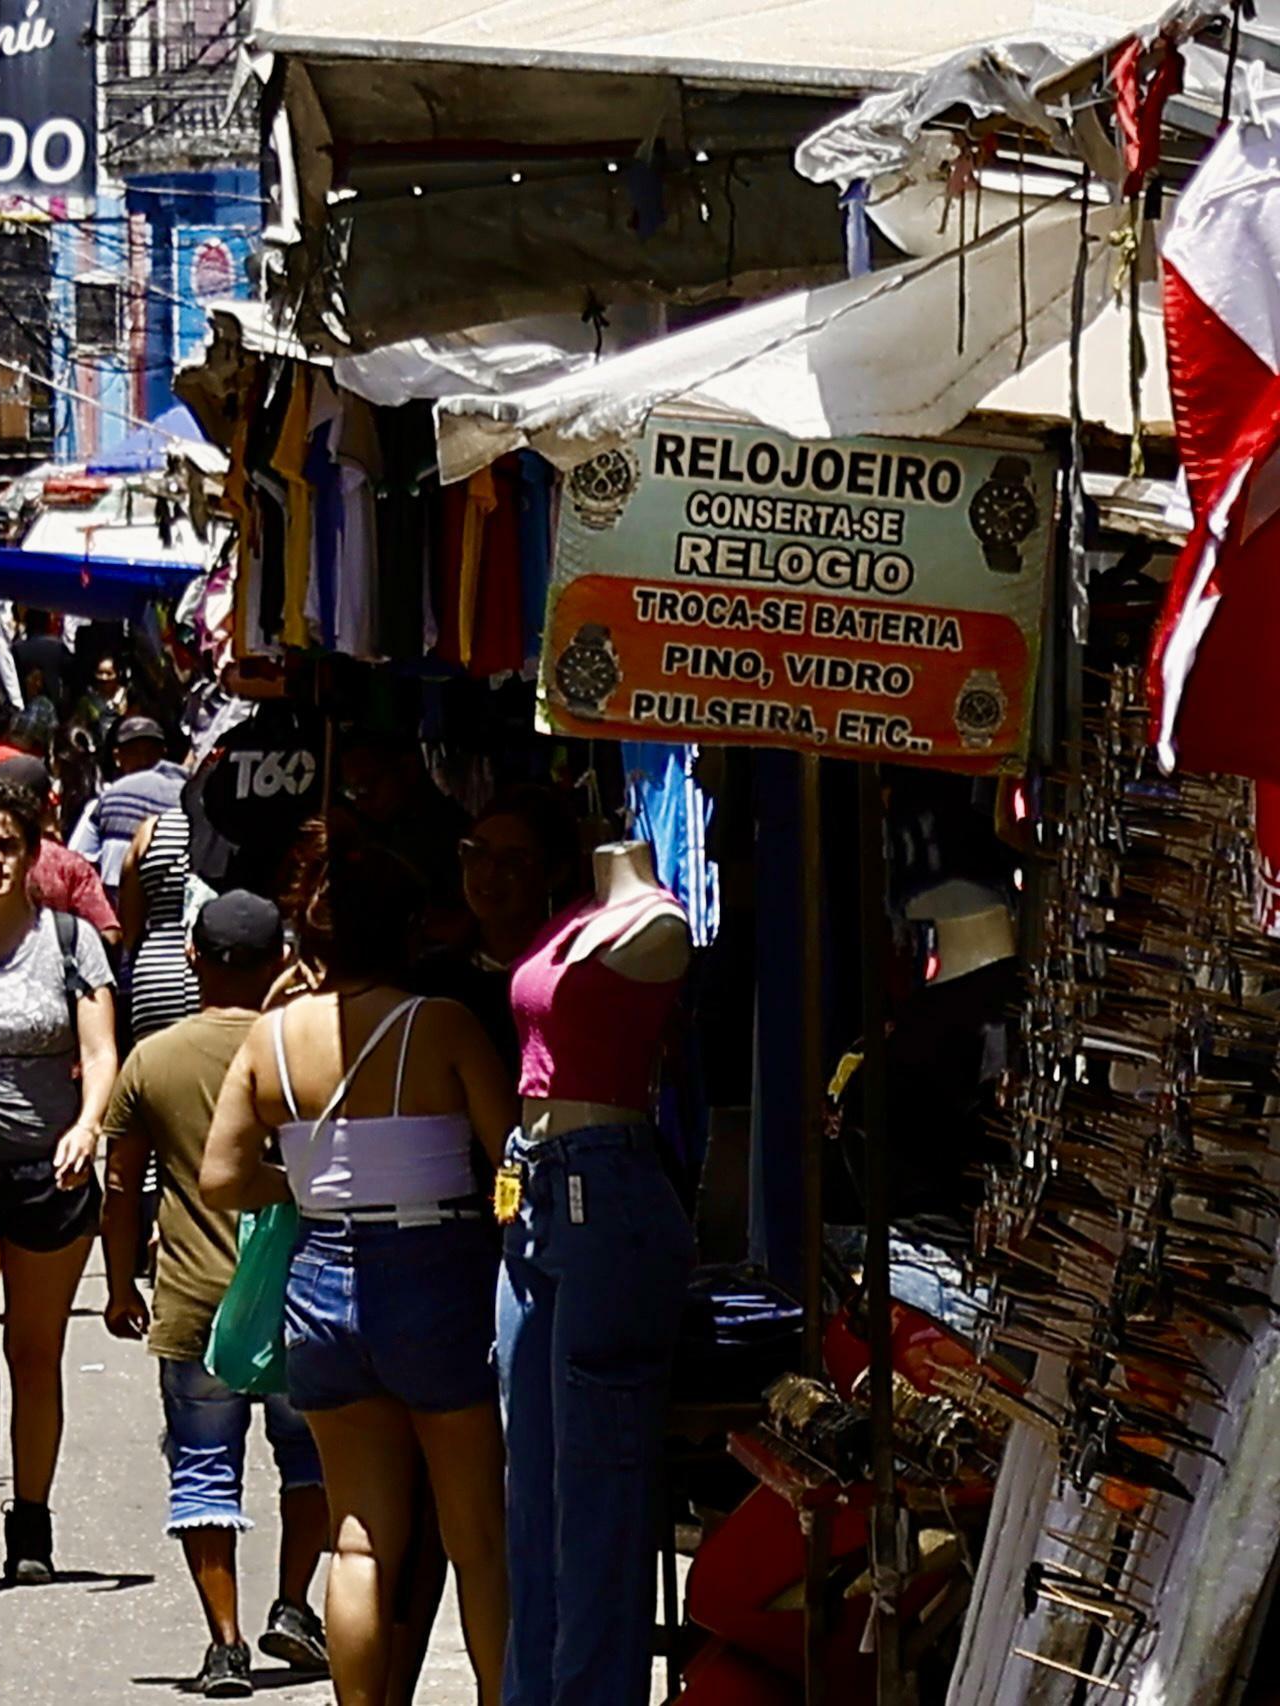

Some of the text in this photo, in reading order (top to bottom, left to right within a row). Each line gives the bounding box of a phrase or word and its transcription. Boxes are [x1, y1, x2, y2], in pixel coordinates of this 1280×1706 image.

[652, 431, 963, 506] RELOJOEIRO
[687, 491, 903, 544] CONSERTA-SE
[676, 533, 913, 594] RELOGIO
[635, 589, 962, 650] TROCA-SE BATERIA
[663, 644, 912, 696] PINO, VIDRO
[631, 692, 932, 751] PULSEIRA, ETC..
[229, 751, 316, 799] T60
